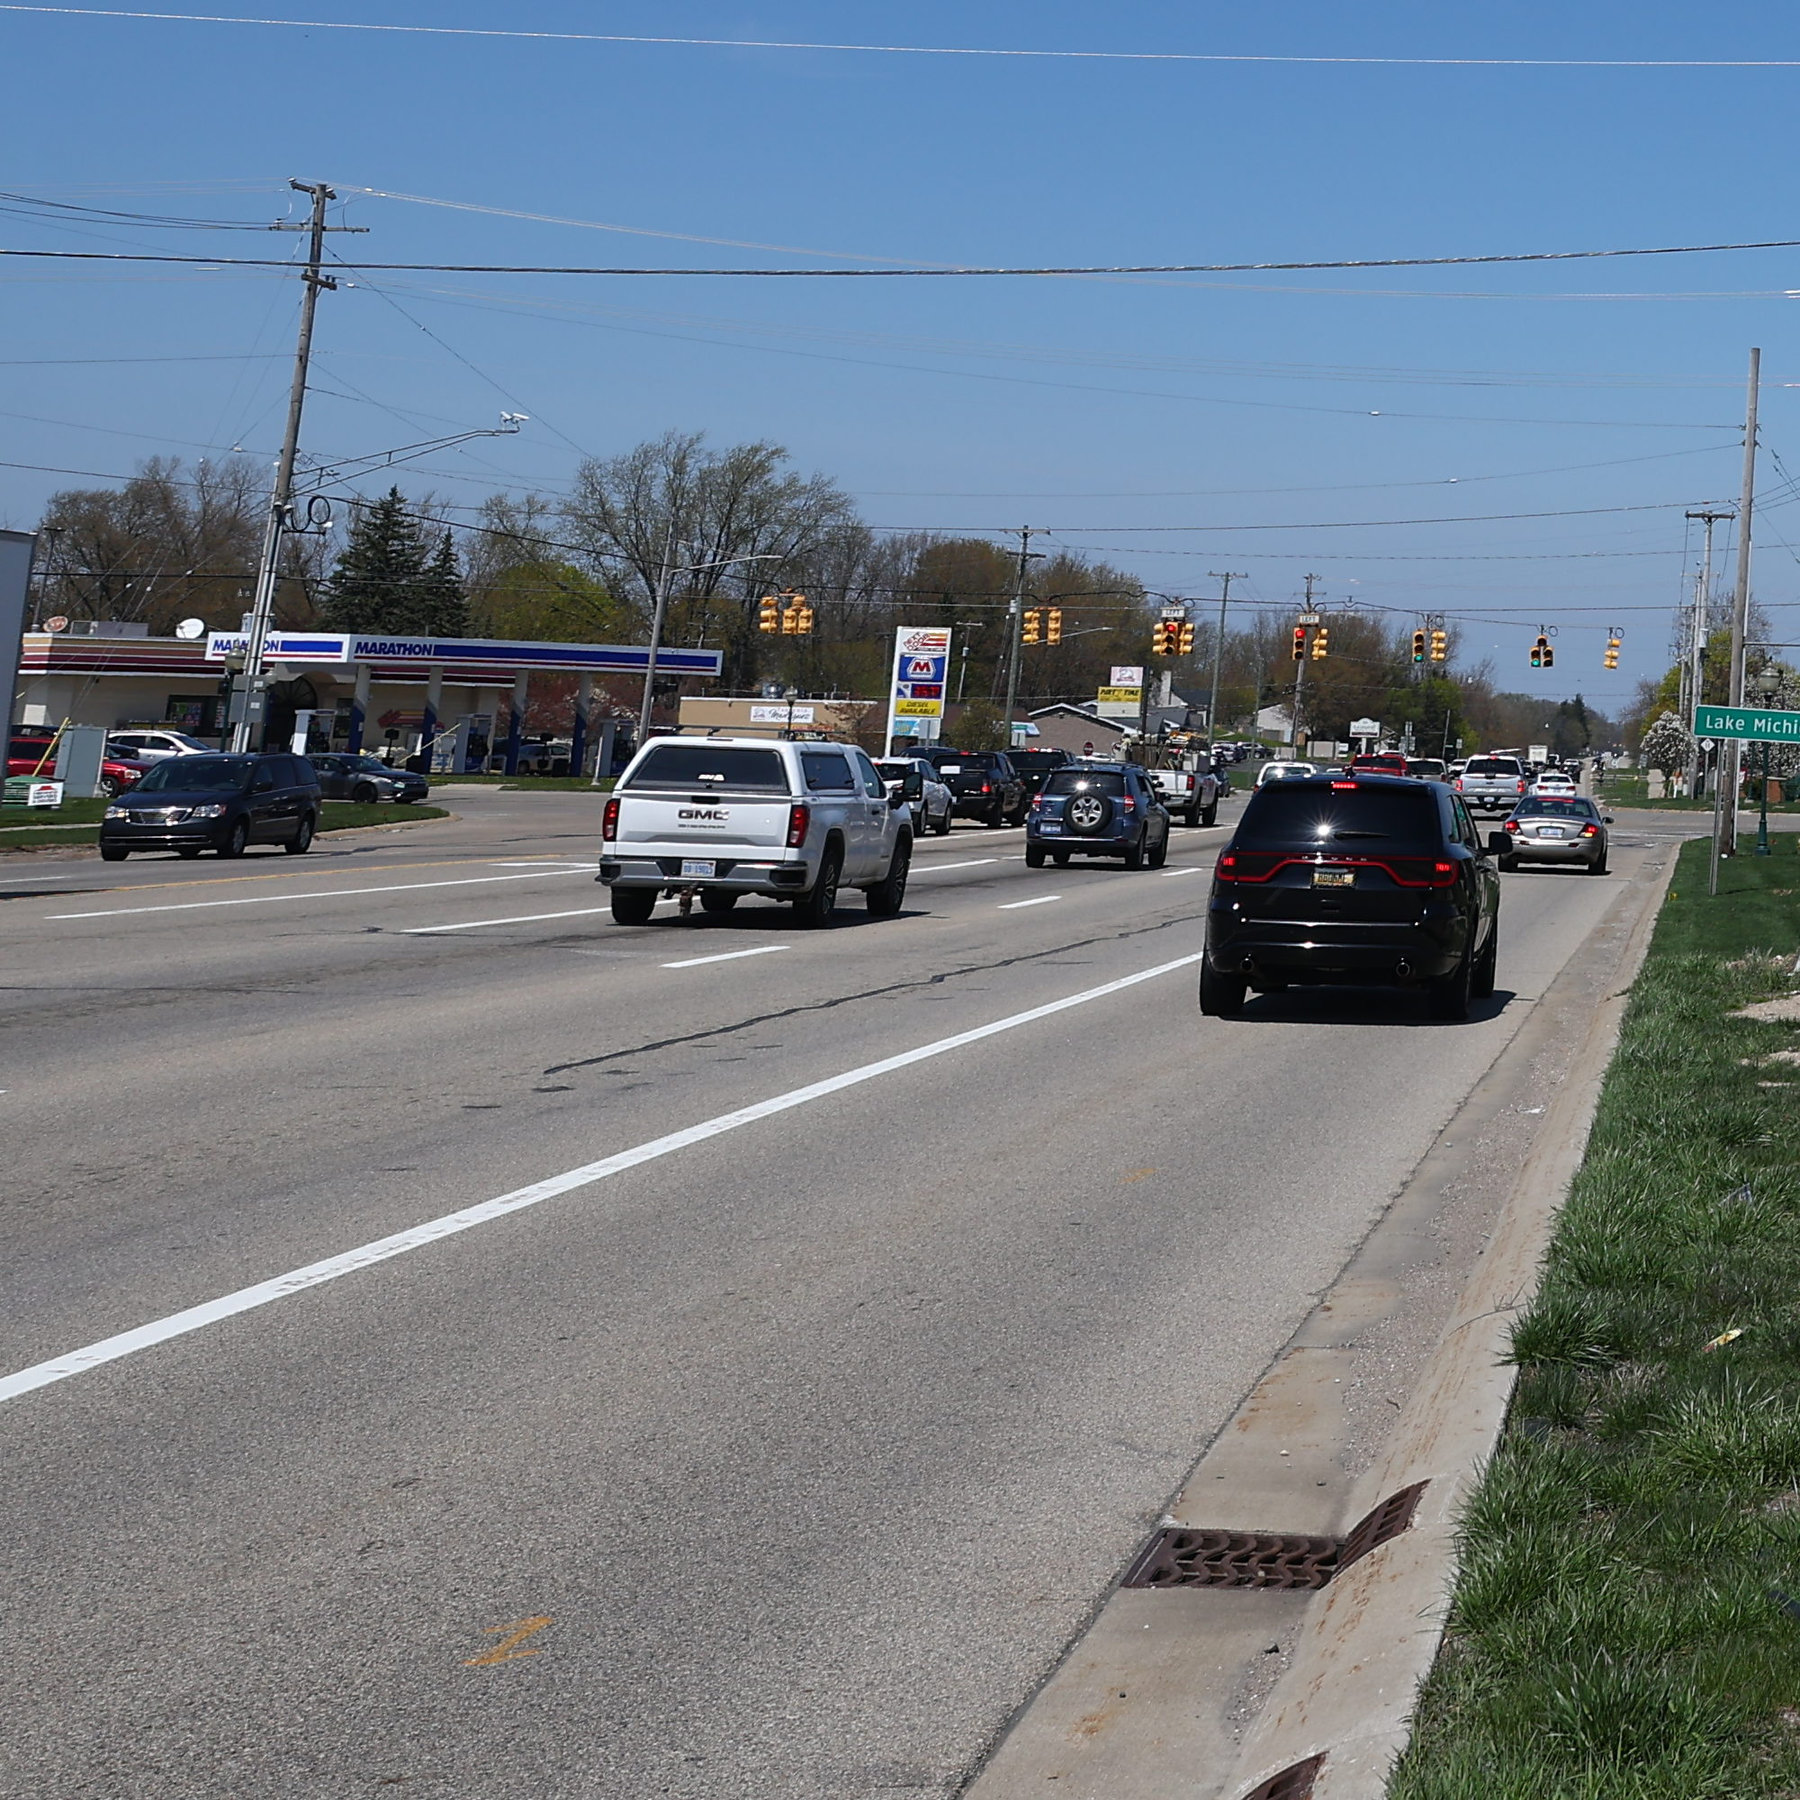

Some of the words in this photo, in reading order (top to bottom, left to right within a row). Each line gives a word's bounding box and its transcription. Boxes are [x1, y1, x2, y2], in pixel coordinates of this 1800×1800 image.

[212, 639, 279, 652] MAAON
[354, 641, 434, 656] MARATHON
[1706, 714, 1745, 730] Lake
[678, 809, 729, 820] GMC
